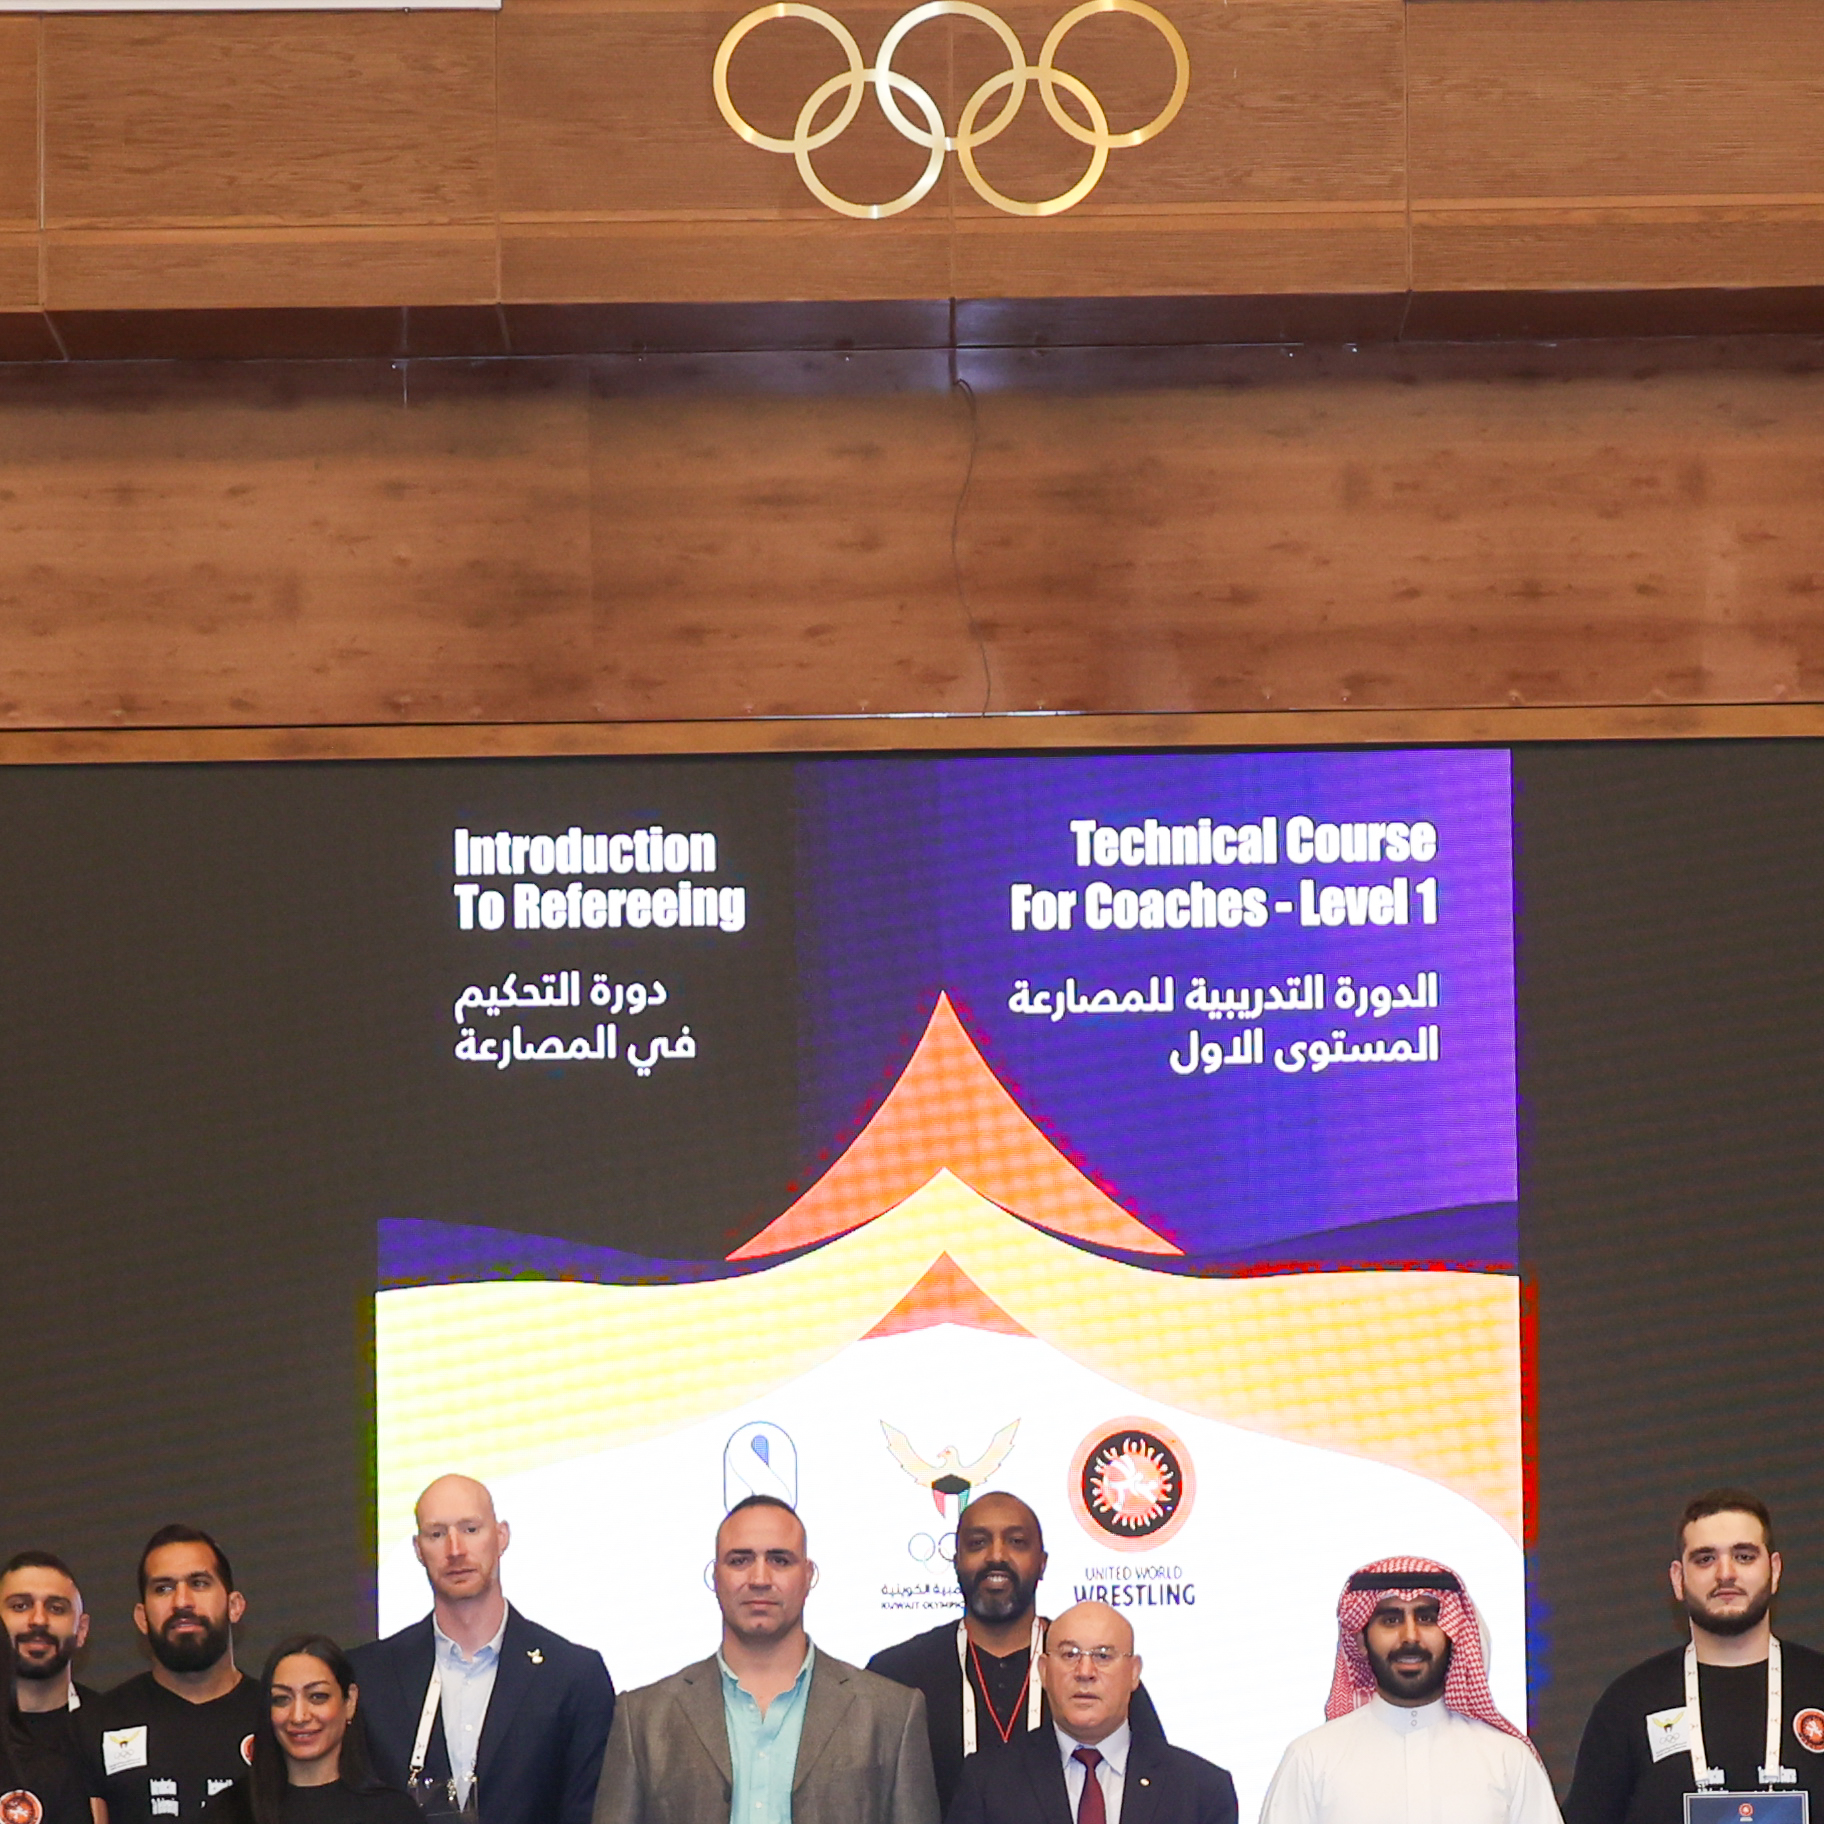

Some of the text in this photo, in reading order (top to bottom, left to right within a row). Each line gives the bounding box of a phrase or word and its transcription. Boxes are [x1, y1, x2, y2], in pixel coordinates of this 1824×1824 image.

[454, 826, 717, 876] Introduction
[1069, 815, 1438, 866] Technical Course
[453, 880, 746, 932] To Refereeing
[1010, 883, 1077, 931] For
[1084, 880, 1269, 930] Coaches
[1299, 877, 1409, 927] Level
[1415, 876, 1438, 925] 1
[453, 969, 667, 1024] دورة التحكيم
[1007, 971, 1439, 1022] الدورة التدريبية للمصارعة
[454, 1022, 696, 1078] في المصارعة
[1168, 1024, 1440, 1075] المستوى الاول
[1073, 1584, 1196, 1606] WRESTLING
[1084, 1565, 1183, 1581] UNITED WORLD
